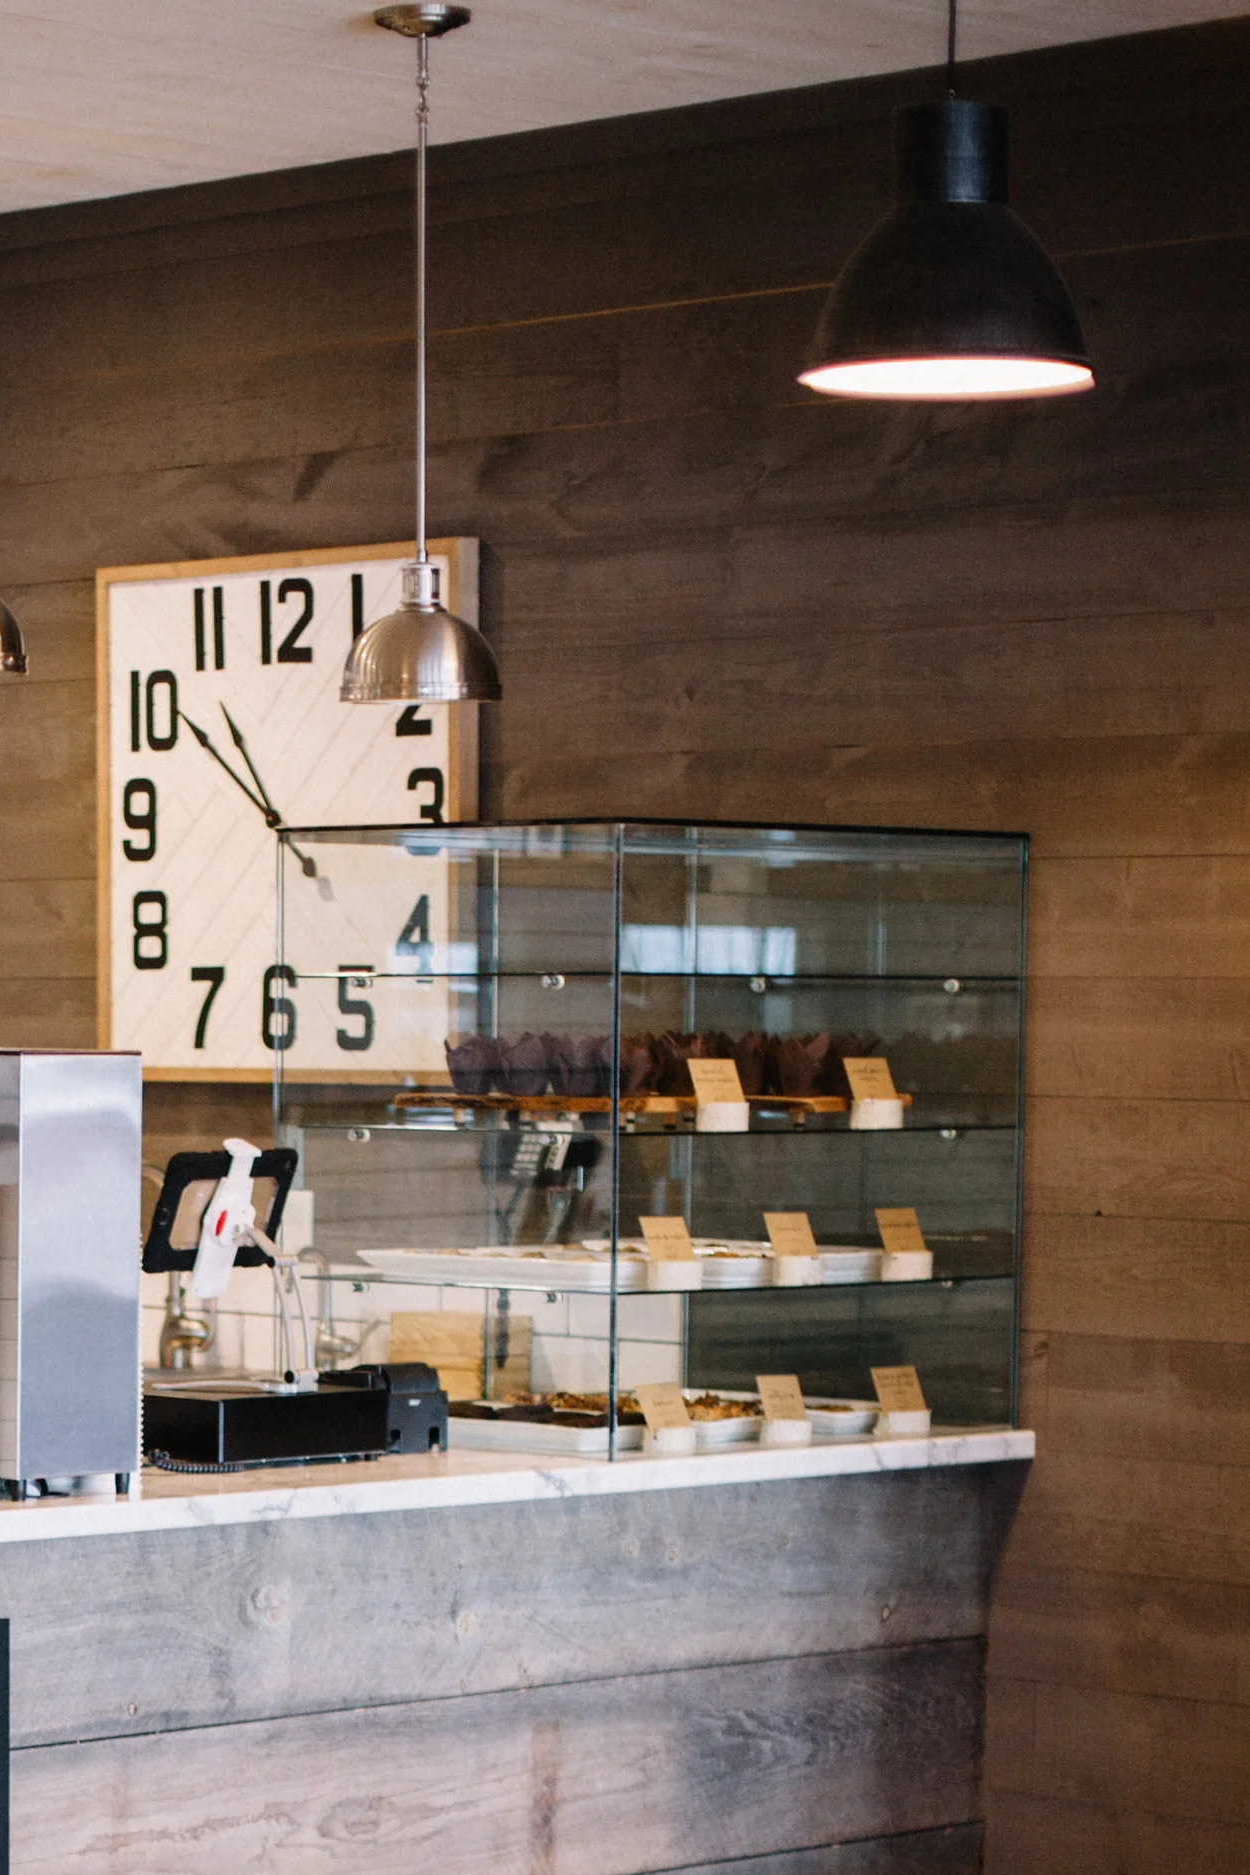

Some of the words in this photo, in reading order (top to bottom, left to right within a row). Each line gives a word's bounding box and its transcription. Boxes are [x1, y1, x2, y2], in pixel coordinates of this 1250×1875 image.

[193, 586, 225, 672] 11
[260, 578, 315, 665] 12
[130, 669, 179, 752] 10
[122, 777, 157, 862] 9
[133, 890, 168, 971] 8
[394, 894, 434, 984] 4
[190, 966, 225, 1050] 7
[261, 964, 298, 1052] 6
[335, 965, 375, 1052] 5
